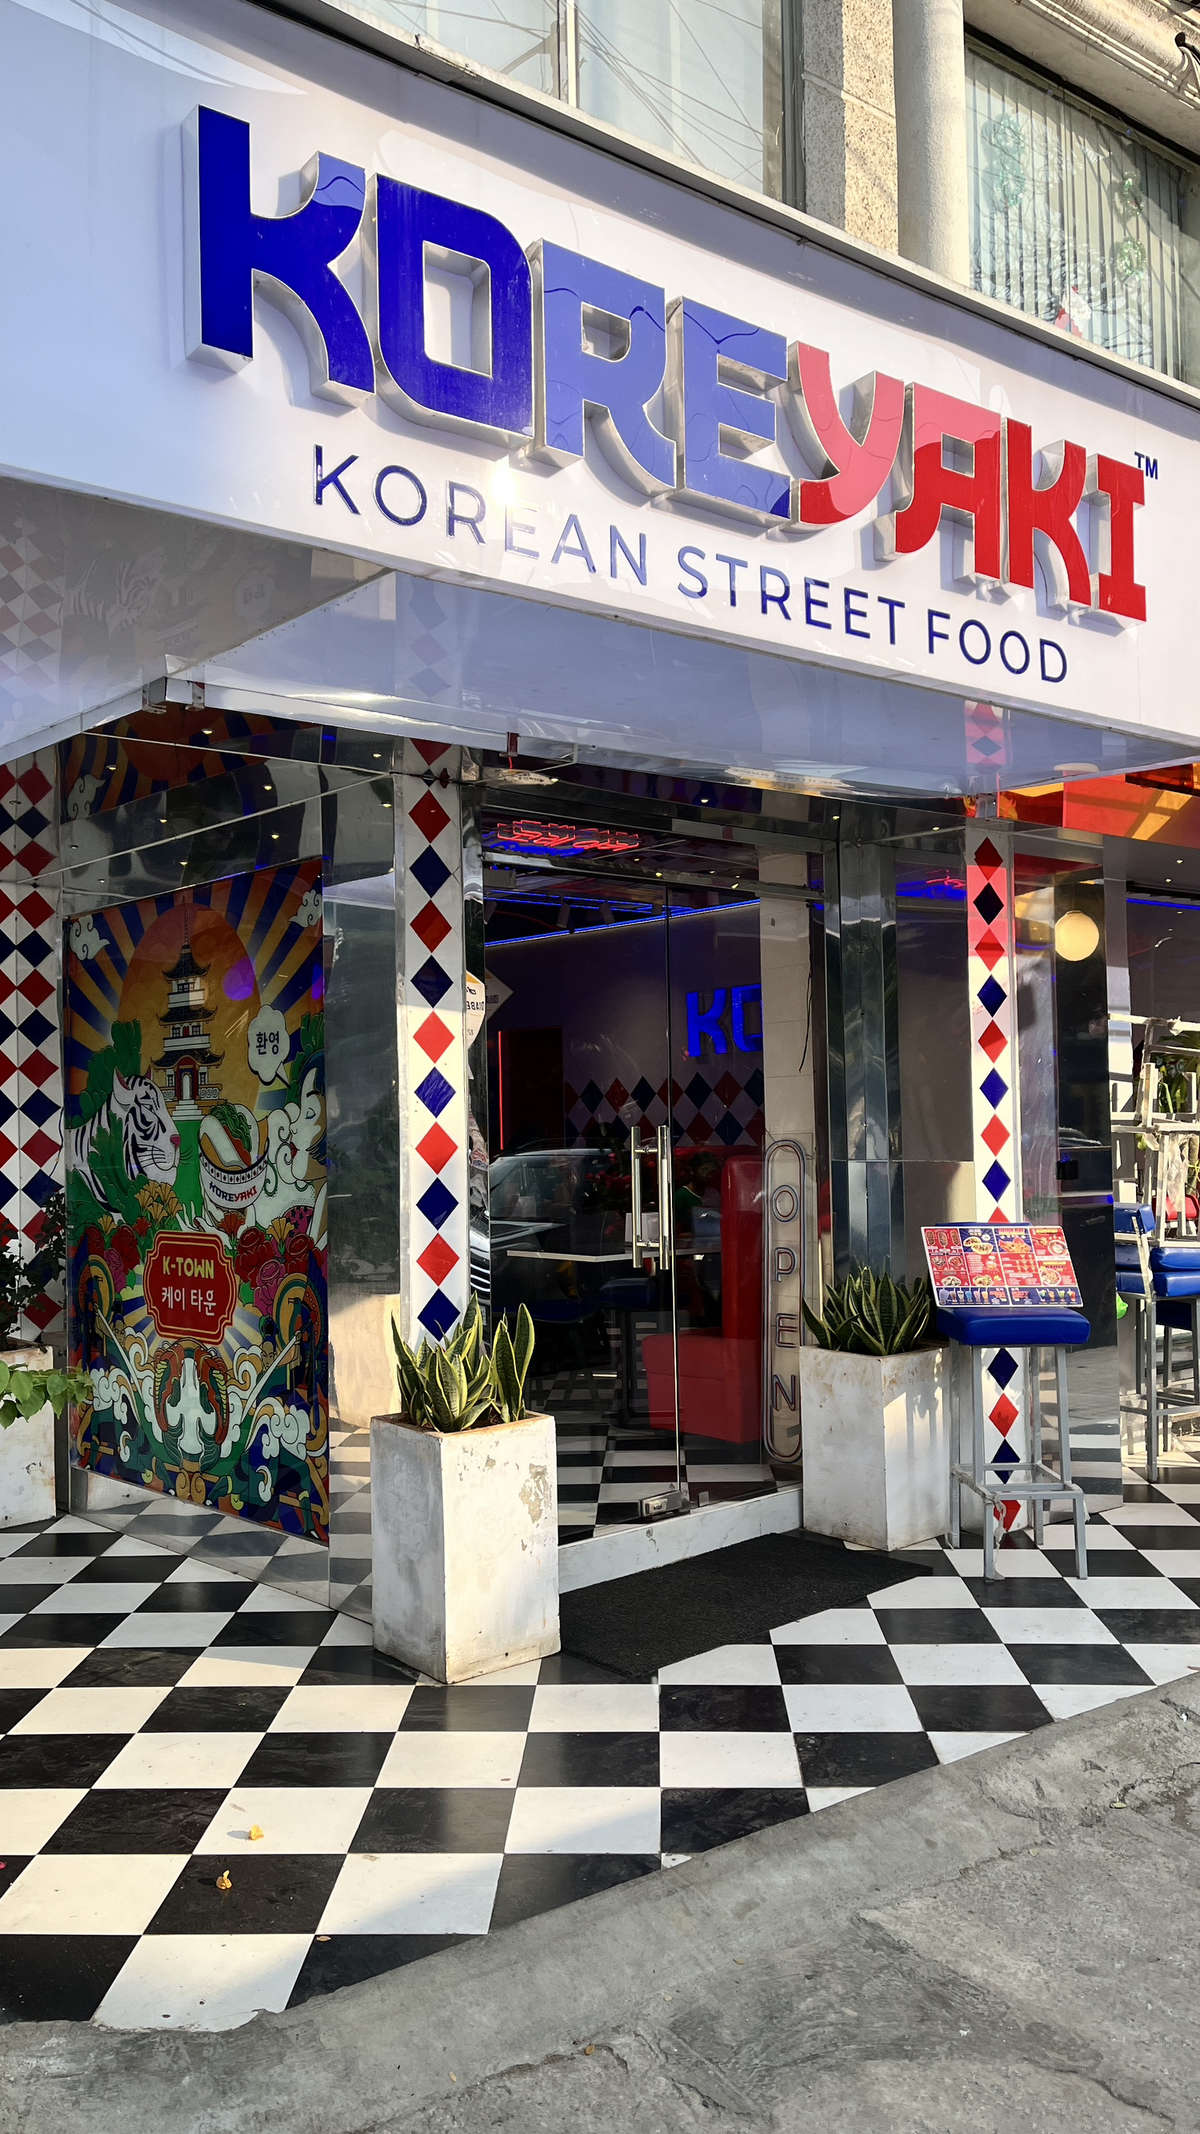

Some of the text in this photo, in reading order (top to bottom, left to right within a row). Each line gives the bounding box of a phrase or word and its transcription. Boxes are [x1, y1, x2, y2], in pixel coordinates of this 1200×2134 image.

[196, 104, 1147, 622] KOREYAKI
[1134, 451, 1158, 480] TM
[313, 443, 1068, 684] KOREAN STREET FOOD
[256, 1031, 279, 1055] 환영
[208, 1181, 258, 1202] KOREYAKI
[162, 1255, 215, 1280] K-TOWN
[161, 1286, 217, 1317] 케이 타운
[771, 1184, 799, 1412] OPEN
